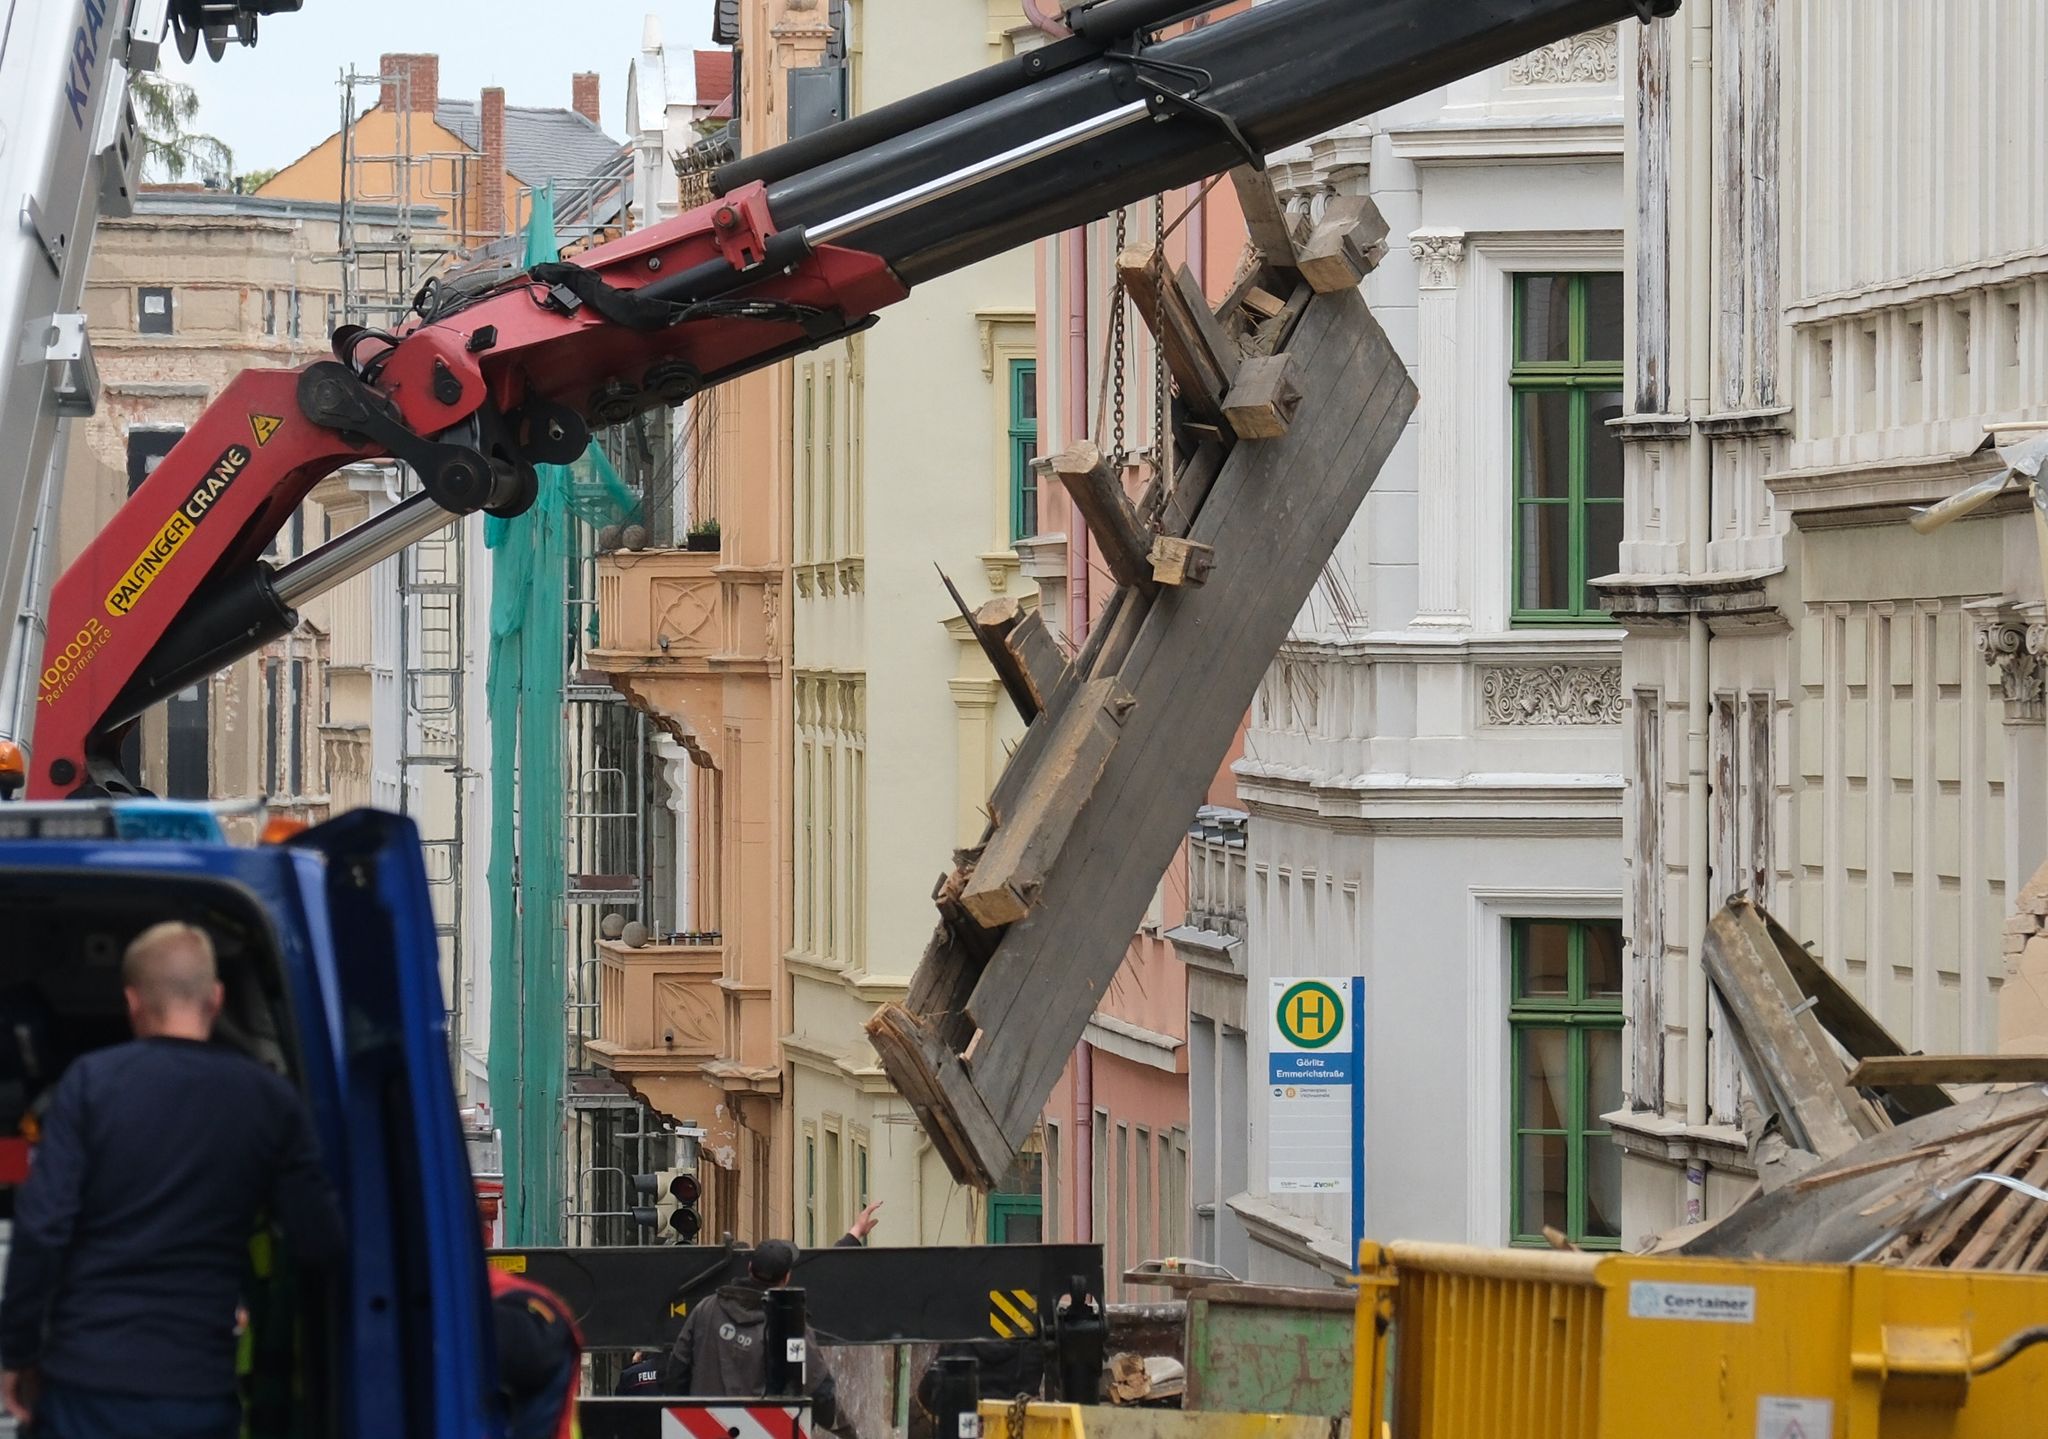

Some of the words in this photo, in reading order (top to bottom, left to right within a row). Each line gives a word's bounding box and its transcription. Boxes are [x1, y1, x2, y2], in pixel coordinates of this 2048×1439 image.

[109, 517, 191, 612] PALFINGER
[185, 448, 246, 518] CRANE
[45, 628, 112, 707] Performance
[1296, 996, 1324, 1034] H
[1276, 1069, 1345, 1078] Emmerichstraße
[1296, 1058, 1325, 1067] Görlitz
[1664, 1294, 1748, 1310] Container
